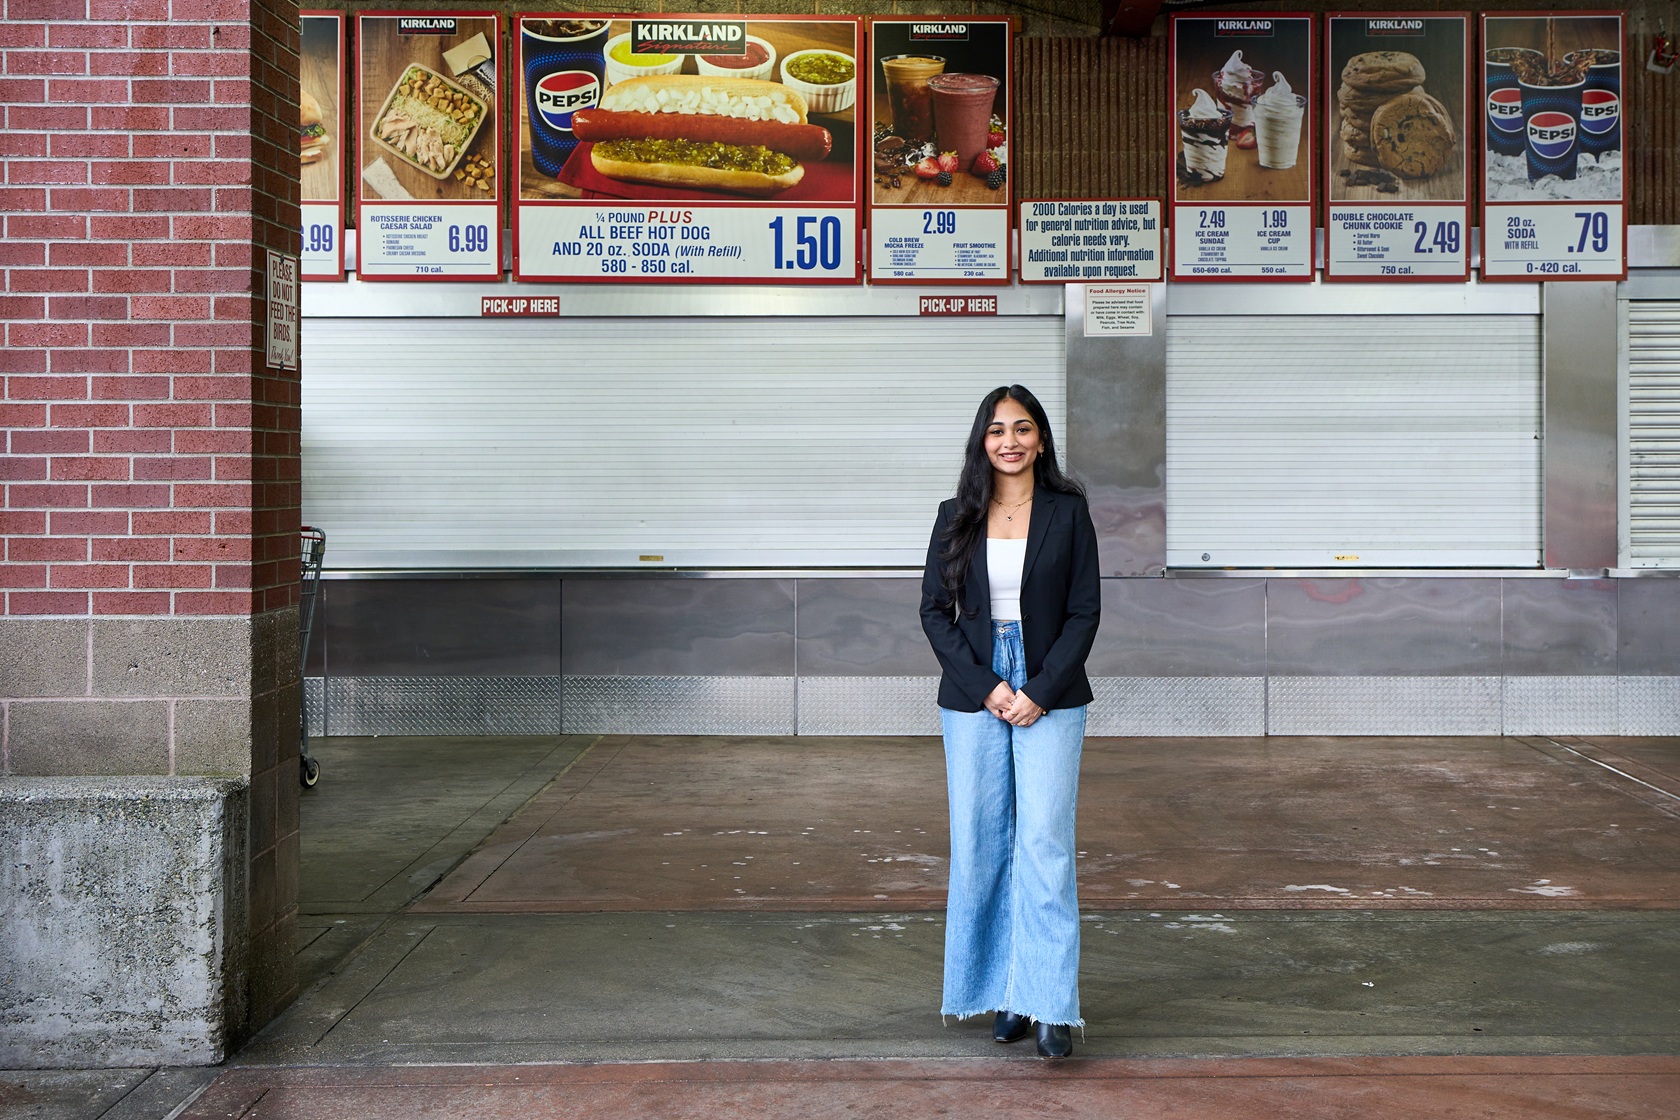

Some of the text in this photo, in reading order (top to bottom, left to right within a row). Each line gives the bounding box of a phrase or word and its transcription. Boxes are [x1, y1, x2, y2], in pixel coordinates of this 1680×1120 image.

[401, 19, 455, 28] KIRKLAND
[913, 25, 966, 33] KIRKLAND
[1218, 21, 1271, 29] KIRKLAND
[1369, 21, 1422, 29] KIRKLAND
[638, 24, 741, 41] KIRKLAND
[638, 40, 741, 54] Signature
[539, 89, 597, 107] PEPSI
[1489, 102, 1522, 114] PEP
[1582, 104, 1617, 117] EPSI
[1530, 127, 1574, 140] PEPSI
[1033, 202, 1148, 217] 2000 Calories a day is used
[609, 213, 644, 222] POUND
[648, 211, 692, 223] PLUS
[923, 211, 955, 234] 2.99
[1200, 211, 1225, 228] 2.49
[1262, 210, 1287, 228] 1.99
[1333, 213, 1413, 221] DOUBLE CHOCOLATE
[1508, 217, 1520, 226] 20
[1026, 218, 1155, 233] for general nutrition advice, but
[1343, 222, 1402, 230] CHUNK COOKIE
[1568, 212, 1608, 252] .79
[449, 225, 488, 252] 6.99
[579, 226, 710, 240] ALL BEEF HOT DOG
[1052, 233, 1129, 247] calorie needs vary.
[1414, 221, 1460, 253] 2.49
[1508, 228, 1535, 238] SODA
[769, 216, 841, 270] 1.50
[1505, 241, 1539, 249] WITH REFILL
[552, 242, 741, 259] AND 20 oz. SODA (With Refill)
[1029, 248, 1154, 262] Additional nutrition information
[273, 260, 292, 282] PLEASE
[602, 260, 626, 272] 580
[642, 260, 666, 273] 850
[671, 260, 694, 273] cal.
[1044, 264, 1138, 278] available upon request.
[1381, 266, 1413, 274] 750 cal.
[1563, 262, 1581, 272] cal.
[273, 281, 292, 302] DO NOT
[271, 301, 295, 322] FEED THE
[483, 299, 557, 313] PICK-UP HERE
[921, 299, 995, 312] PICK-UP HERE
[274, 322, 291, 342] BIRDS.
